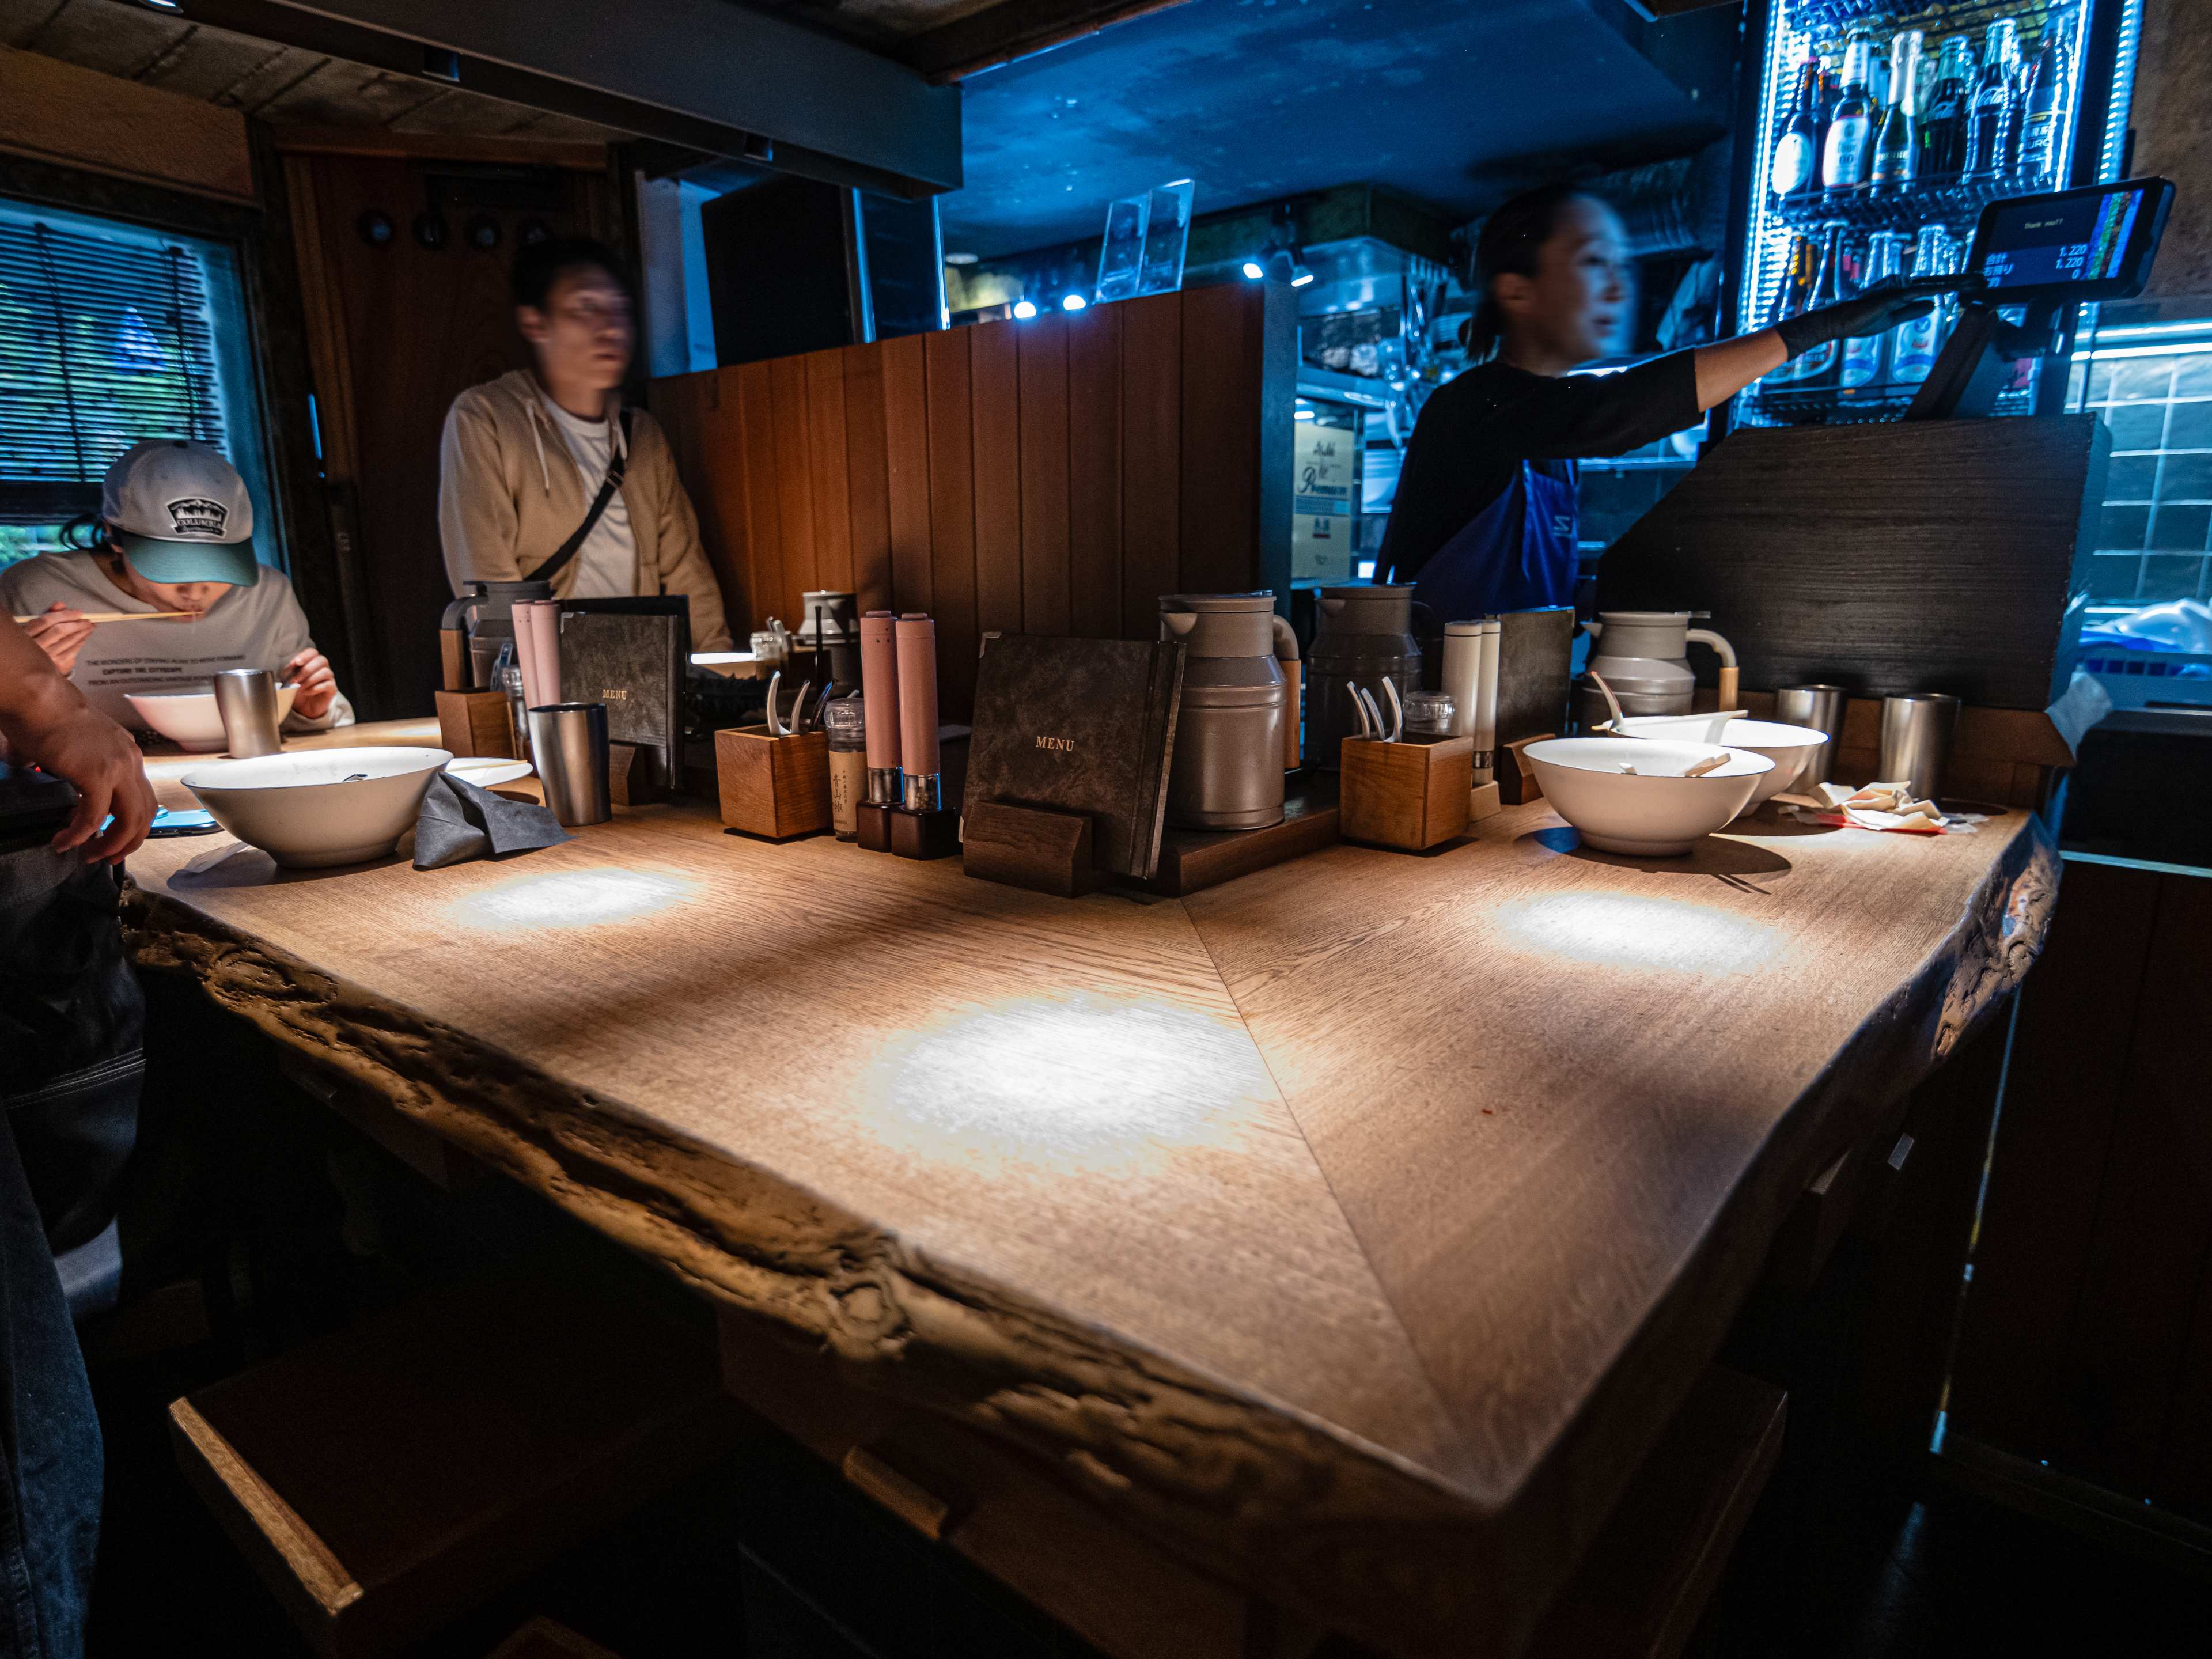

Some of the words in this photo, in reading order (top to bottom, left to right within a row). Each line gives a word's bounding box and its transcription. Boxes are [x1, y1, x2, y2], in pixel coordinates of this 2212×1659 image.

[1986, 252, 2008, 265] 合計
[2072, 268, 2080, 279] 0
[177, 518, 222, 529] COLUMBIA
[603, 689, 627, 700] MENU
[1036, 736, 1074, 752] MENU
